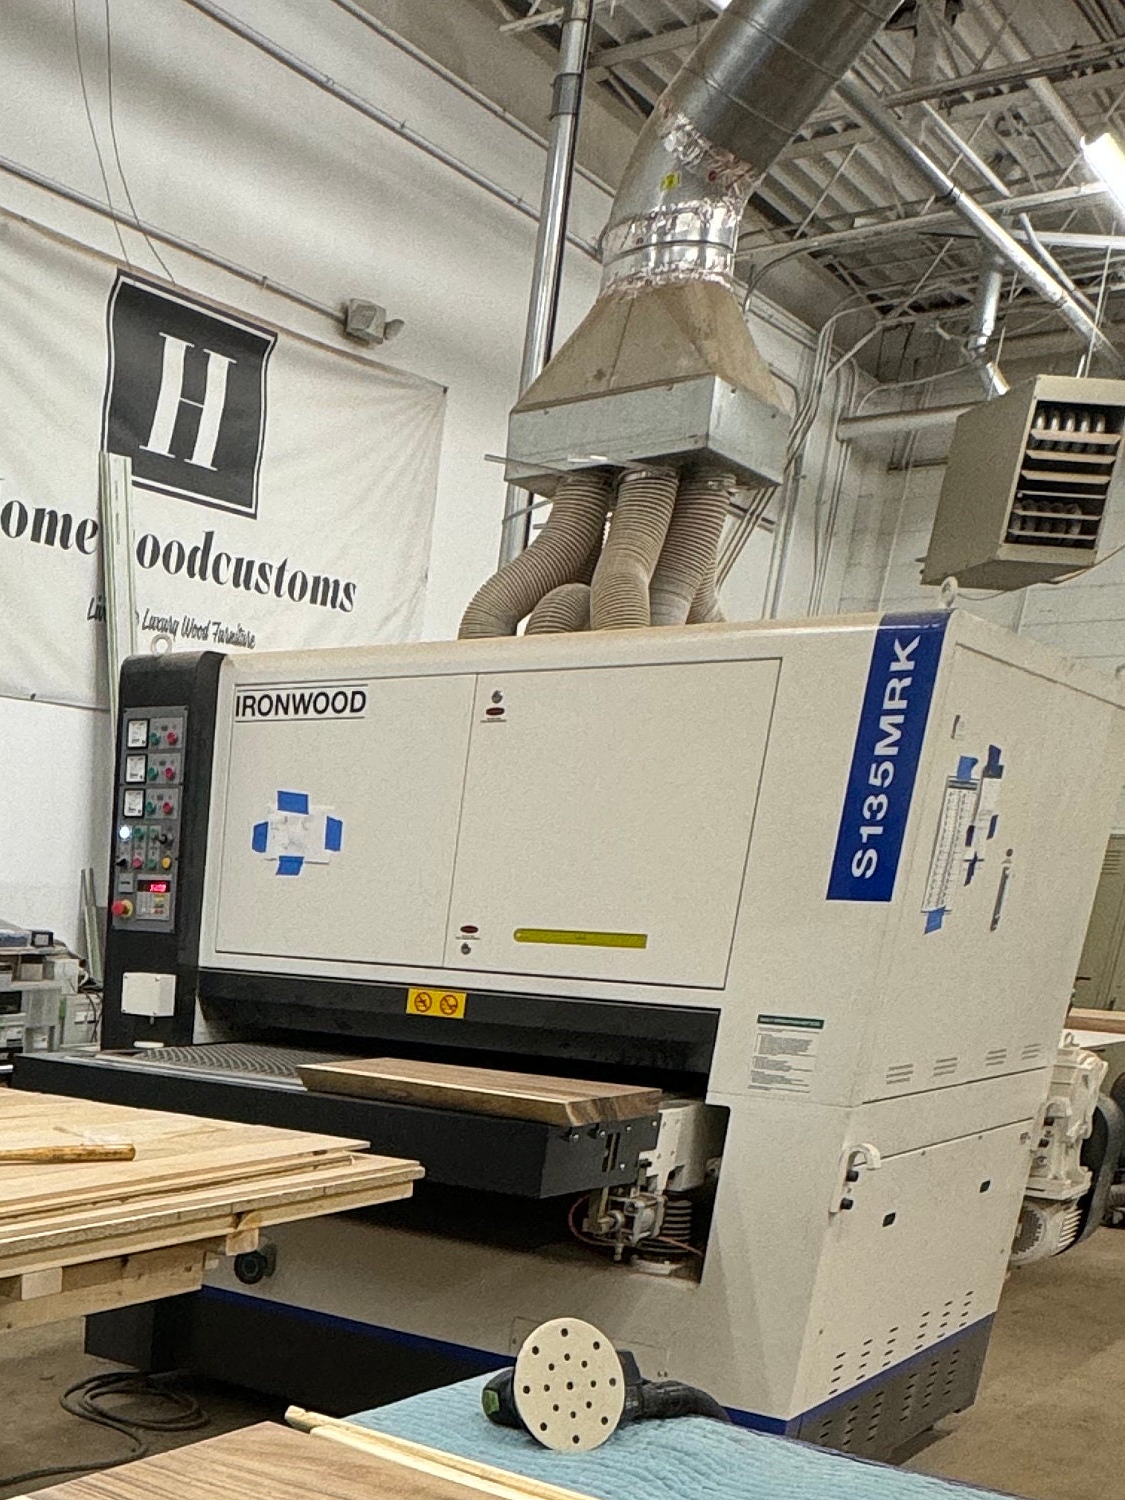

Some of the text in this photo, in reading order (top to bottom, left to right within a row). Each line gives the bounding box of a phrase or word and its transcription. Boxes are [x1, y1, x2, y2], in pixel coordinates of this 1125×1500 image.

[139, 331, 237, 472] H
[181, 615, 211, 641] Wood
[235, 690, 367, 717] IRONWOOD
[851, 635, 921, 879] S135MRK
